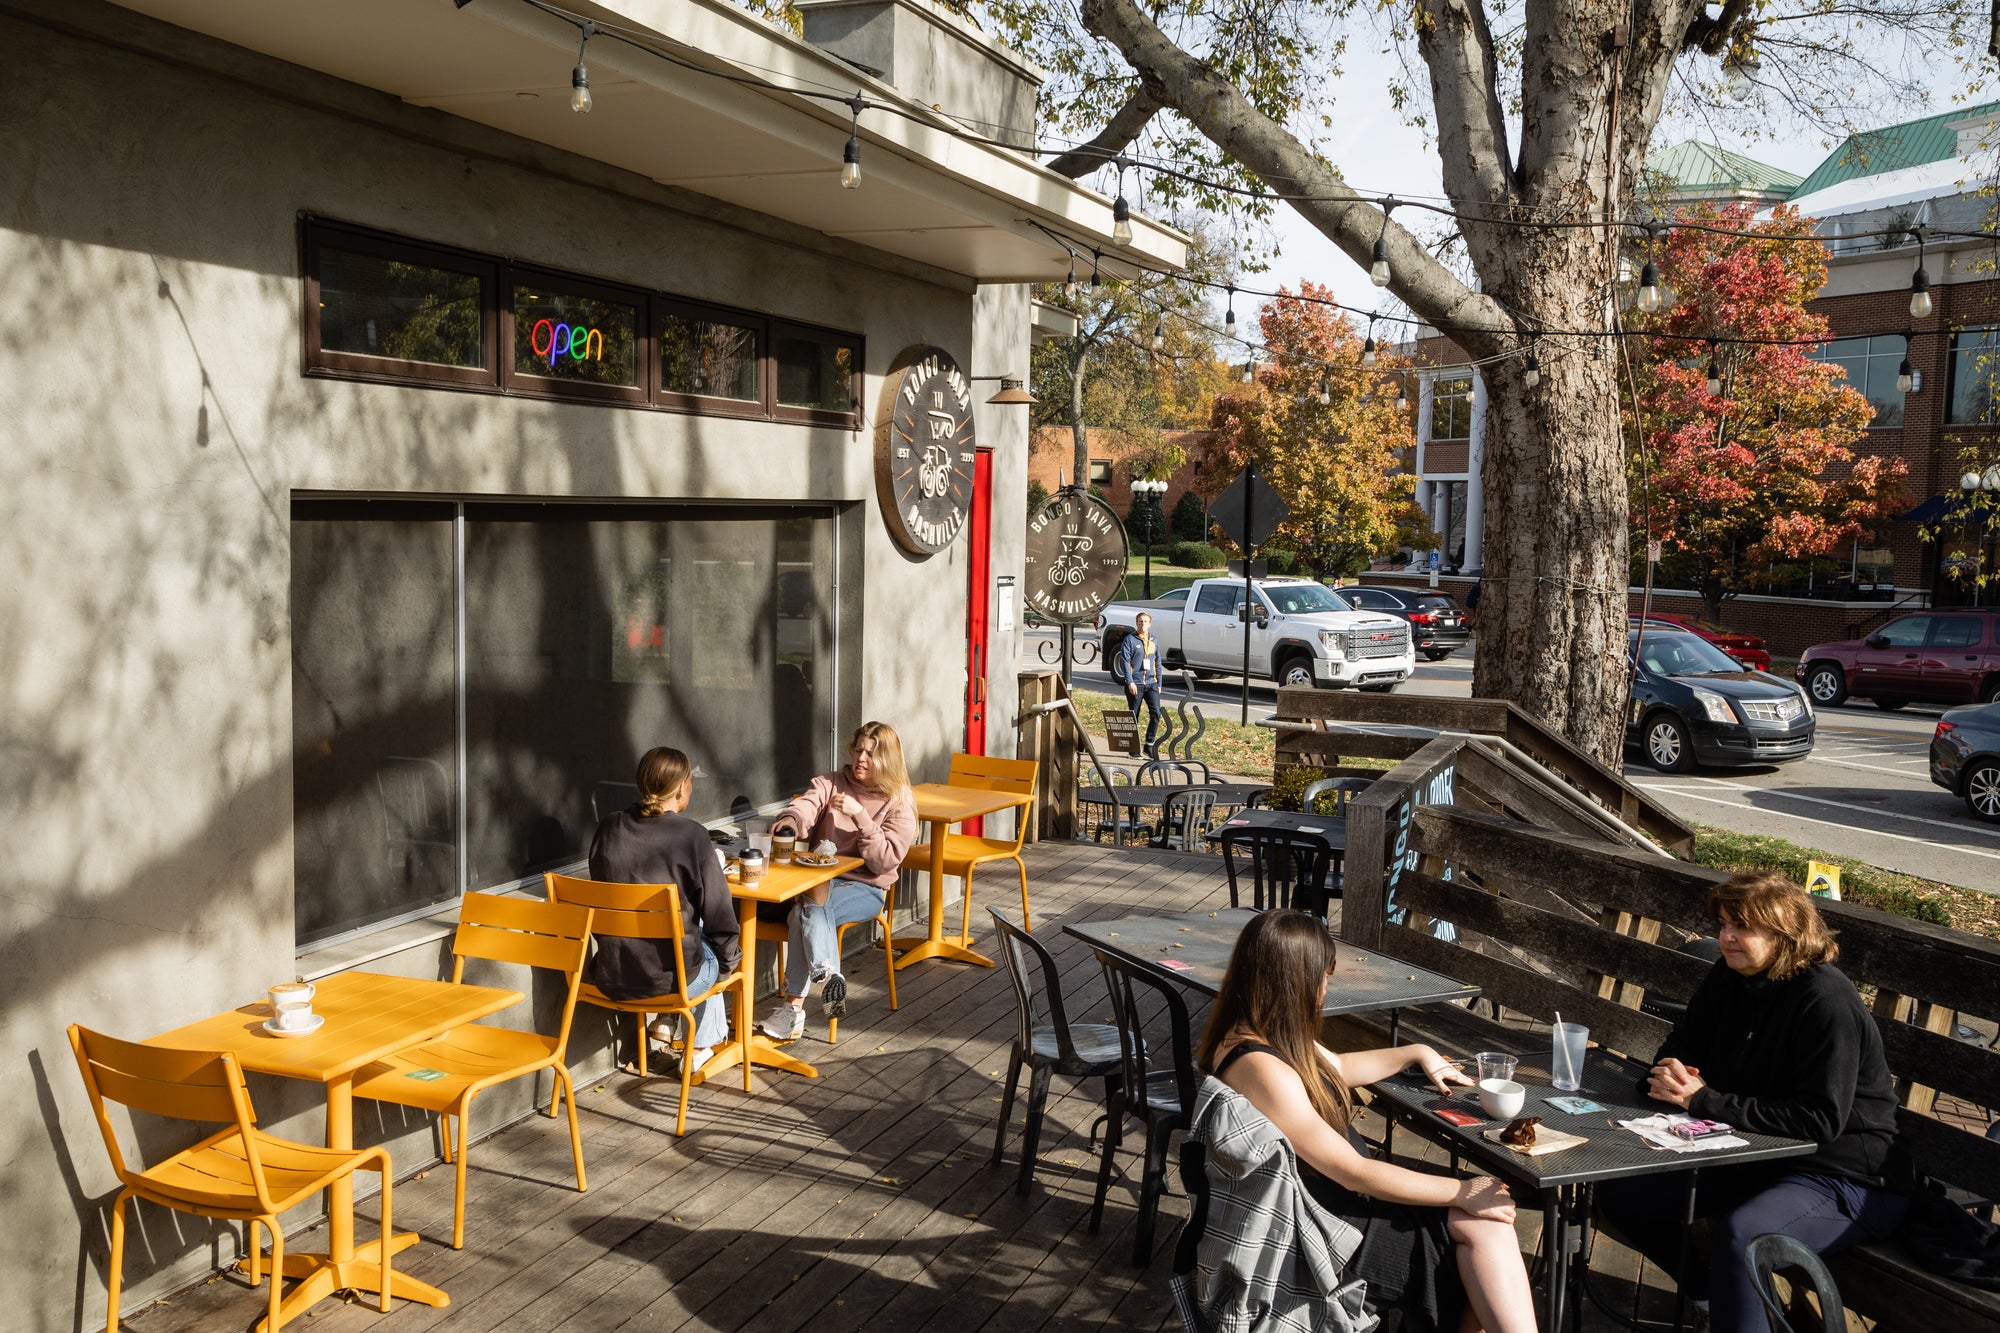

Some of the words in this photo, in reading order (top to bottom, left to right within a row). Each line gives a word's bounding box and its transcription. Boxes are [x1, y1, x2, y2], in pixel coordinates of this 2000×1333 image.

[903, 354, 938, 406] BONGO
[946, 364, 970, 412] JAVA
[908, 504, 962, 546] NASHVILLE
[1030, 502, 1071, 534] BONGO
[1085, 507, 1113, 535] JAVA
[1034, 589, 1101, 614] NASHVILLE
